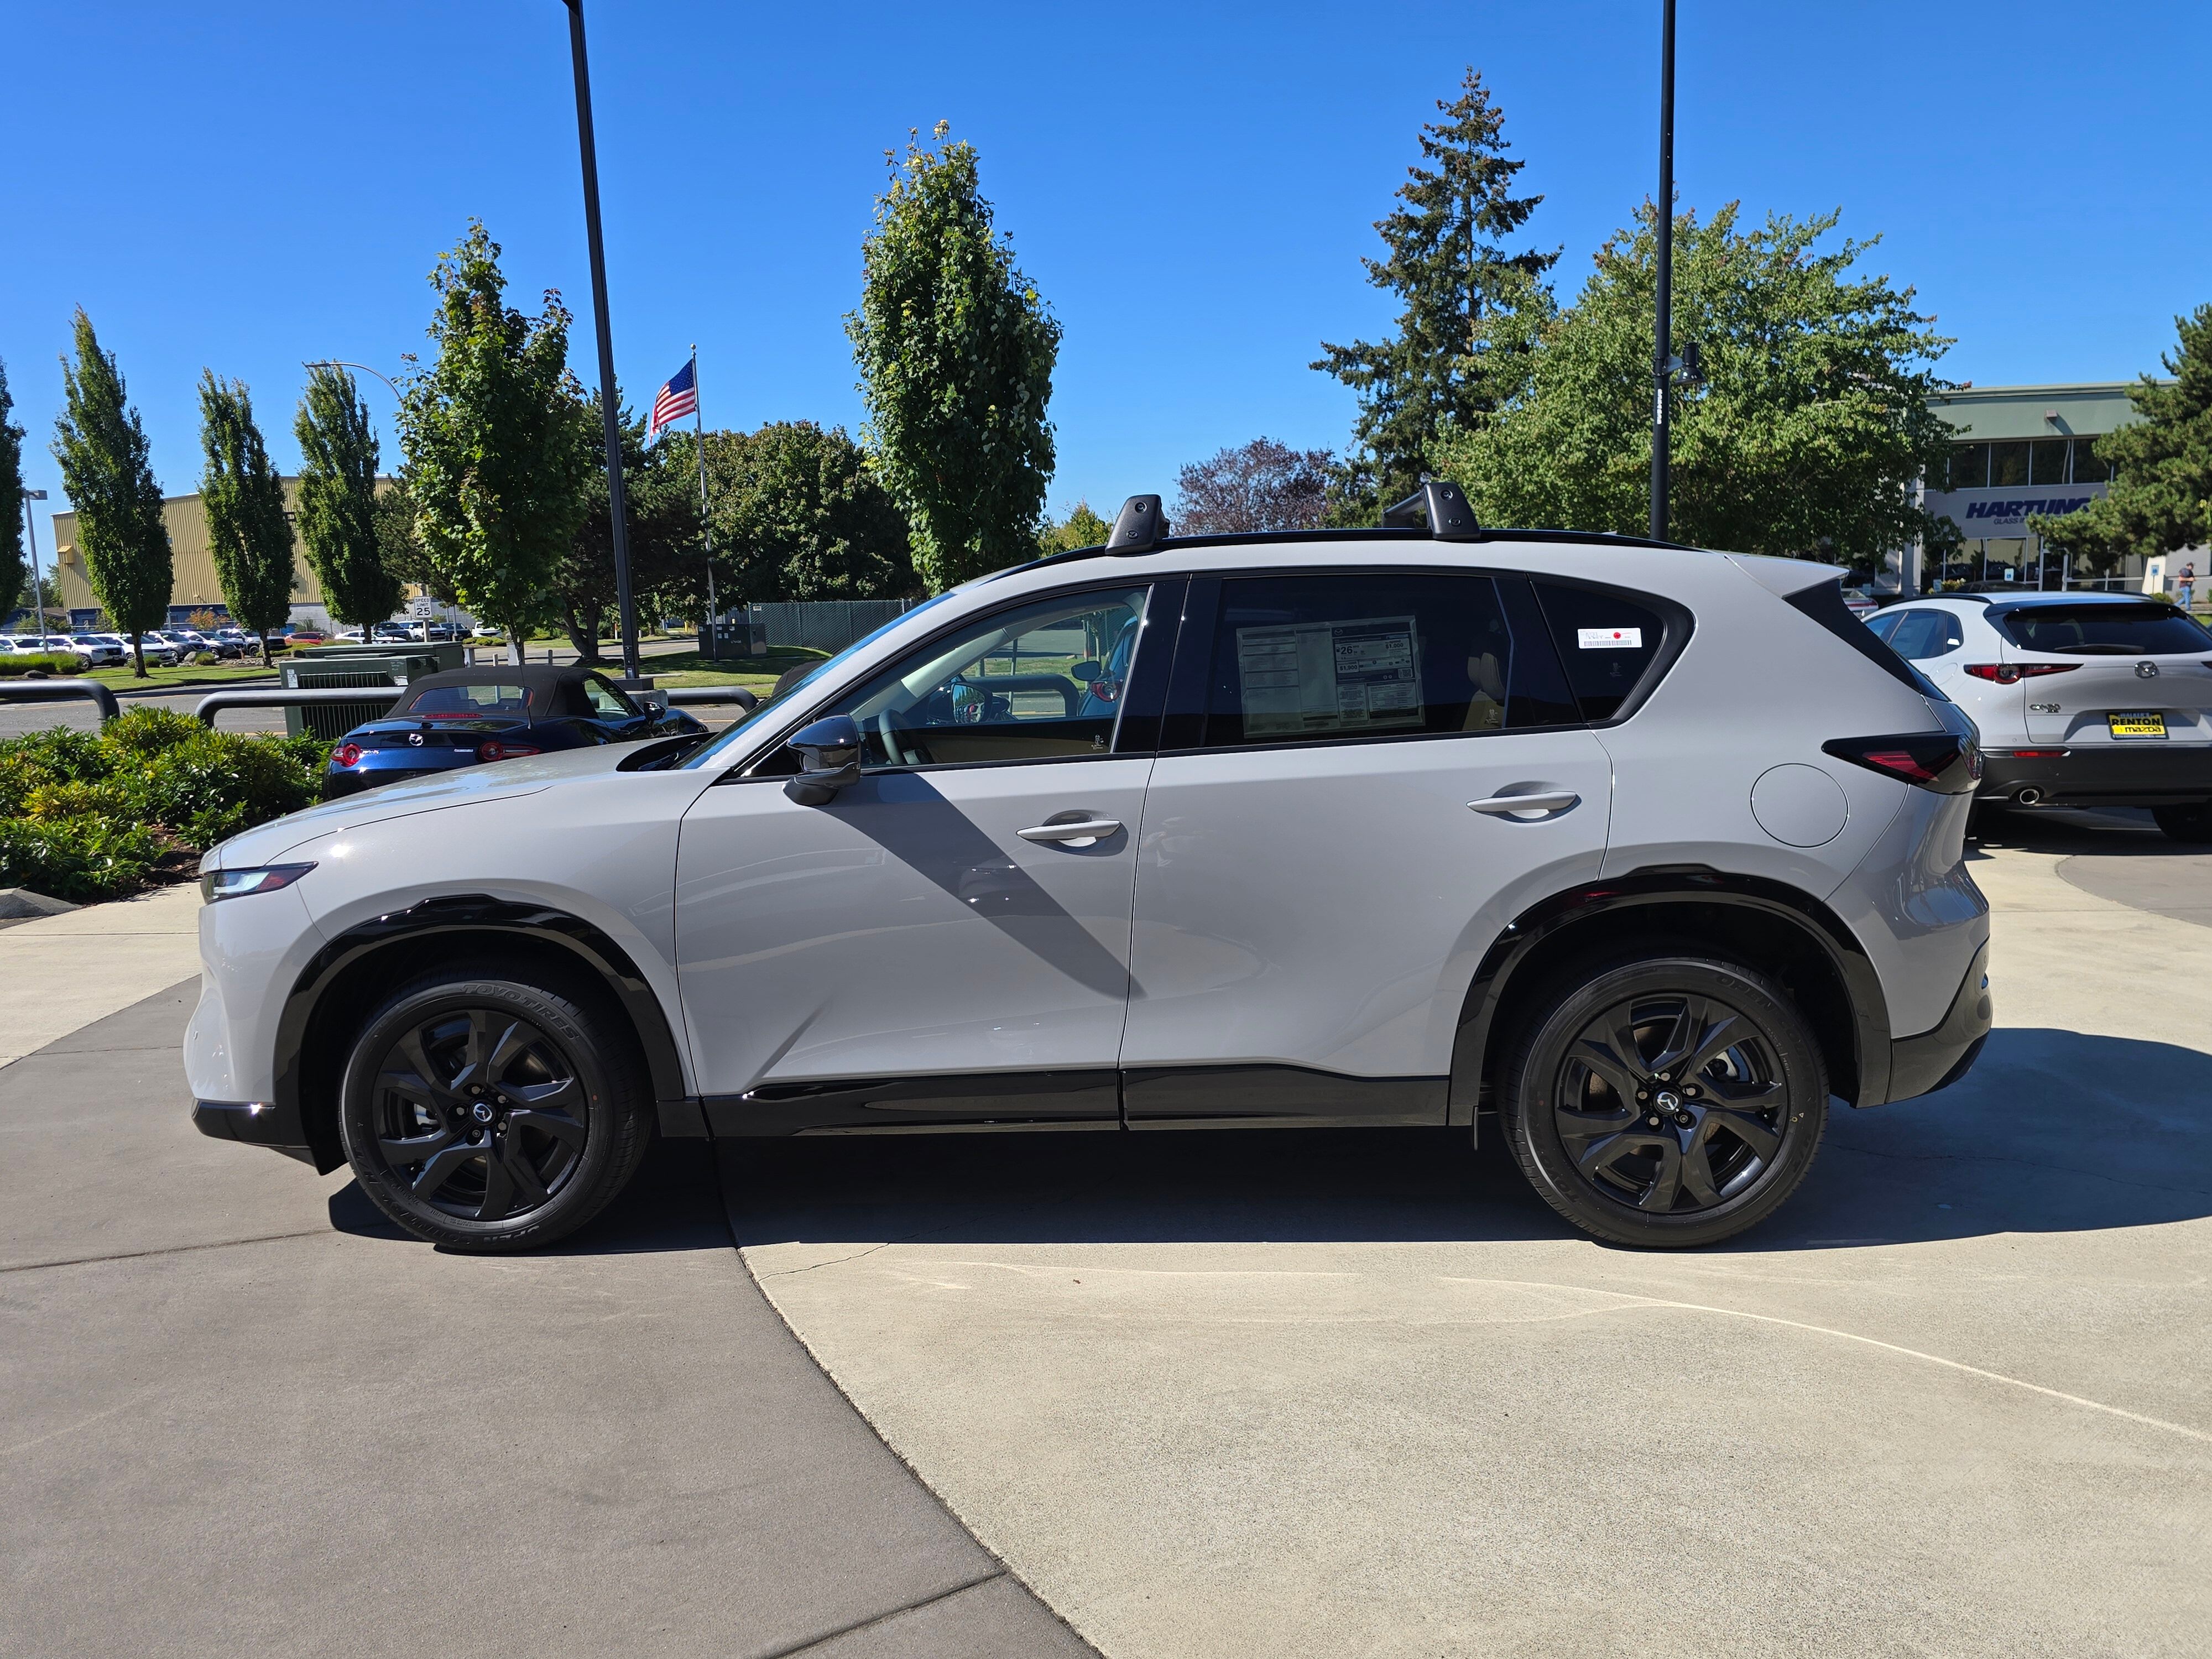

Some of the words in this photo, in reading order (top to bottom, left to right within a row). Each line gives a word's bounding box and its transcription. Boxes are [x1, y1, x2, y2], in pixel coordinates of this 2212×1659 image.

[1994, 517, 2019, 525] GLASS
[416, 607, 430, 615] 25
[1340, 646, 1353, 654] 26
[1717, 974, 1776, 1015] OPEN
[461, 984, 520, 1001] TOYO
[521, 997, 580, 1040] TIRES
[483, 1224, 540, 1245] OPEN
